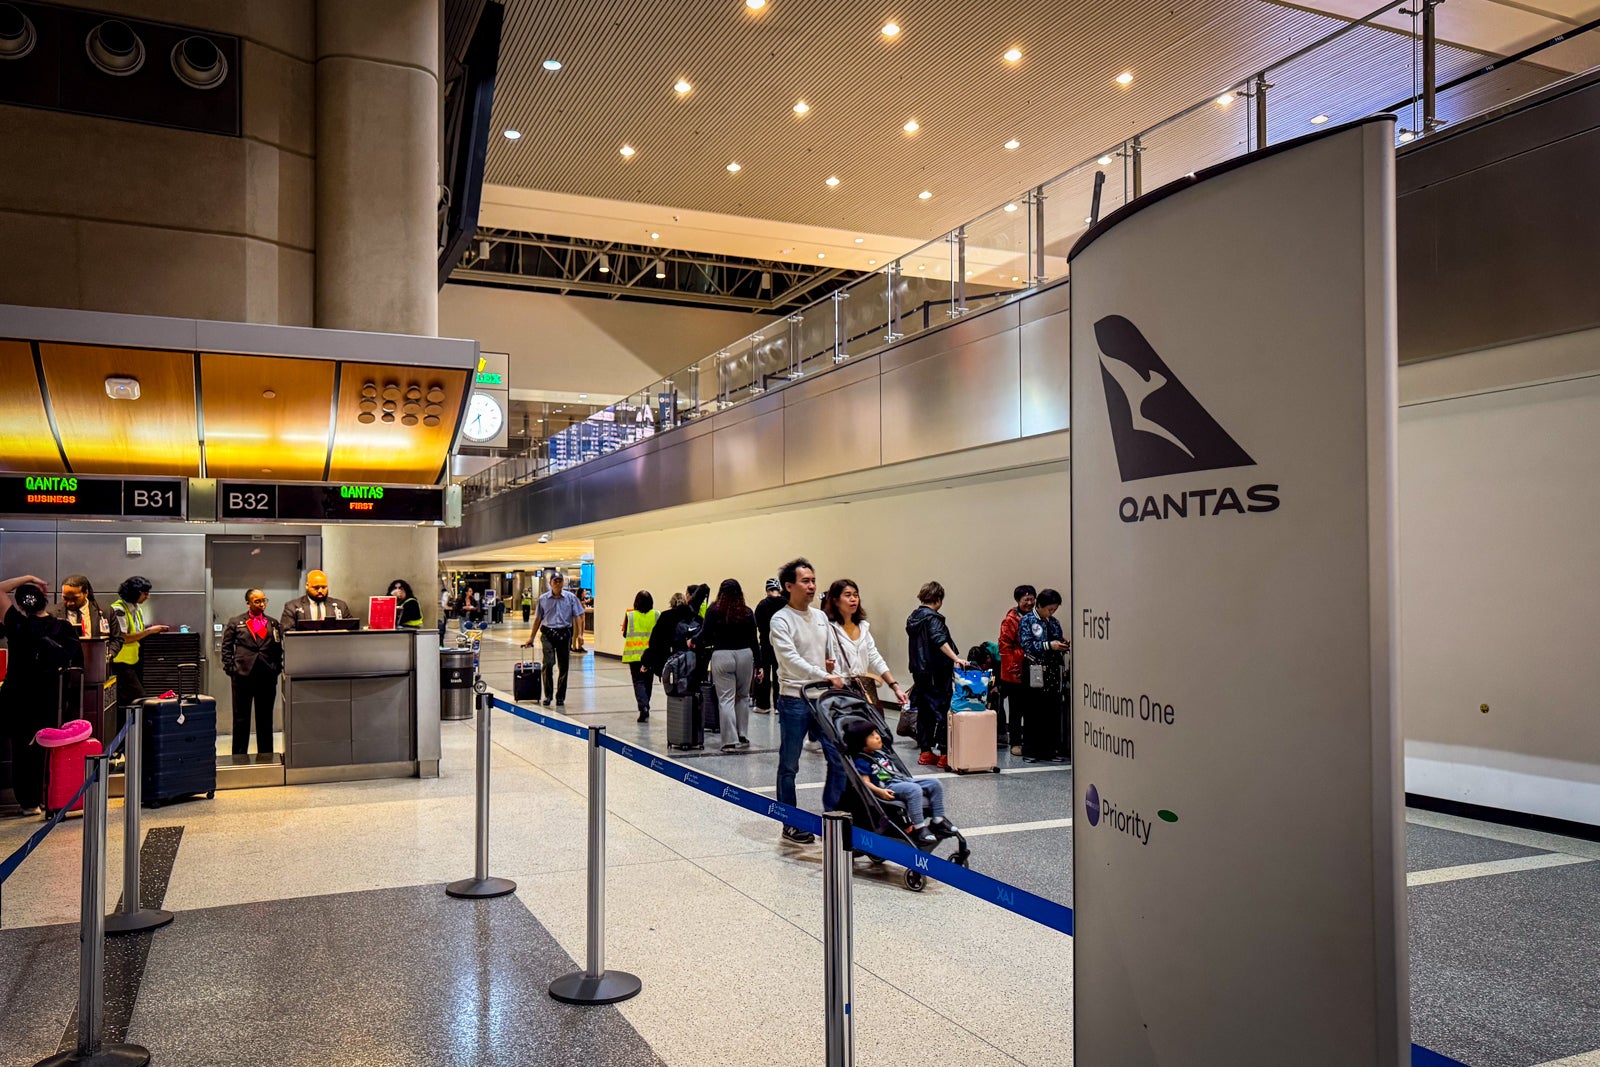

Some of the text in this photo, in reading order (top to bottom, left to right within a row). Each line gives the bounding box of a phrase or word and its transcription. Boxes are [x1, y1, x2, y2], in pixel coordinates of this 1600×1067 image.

[475, 373, 502, 384] LEX
[25, 476, 78, 491] QANTAS
[340, 485, 384, 499] QANTAS
[27, 494, 76, 504] BUSINESS
[134, 489, 174, 508] B31
[229, 492, 269, 510] B32
[349, 502, 374, 510] FIRST
[1118, 484, 1280, 523] QANTAS
[1082, 608, 1111, 641] First
[1083, 683, 1175, 725] Platinum One
[1084, 721, 1135, 760] Platinum
[1102, 798, 1152, 846] Priority
[914, 854, 929, 871] LAX
